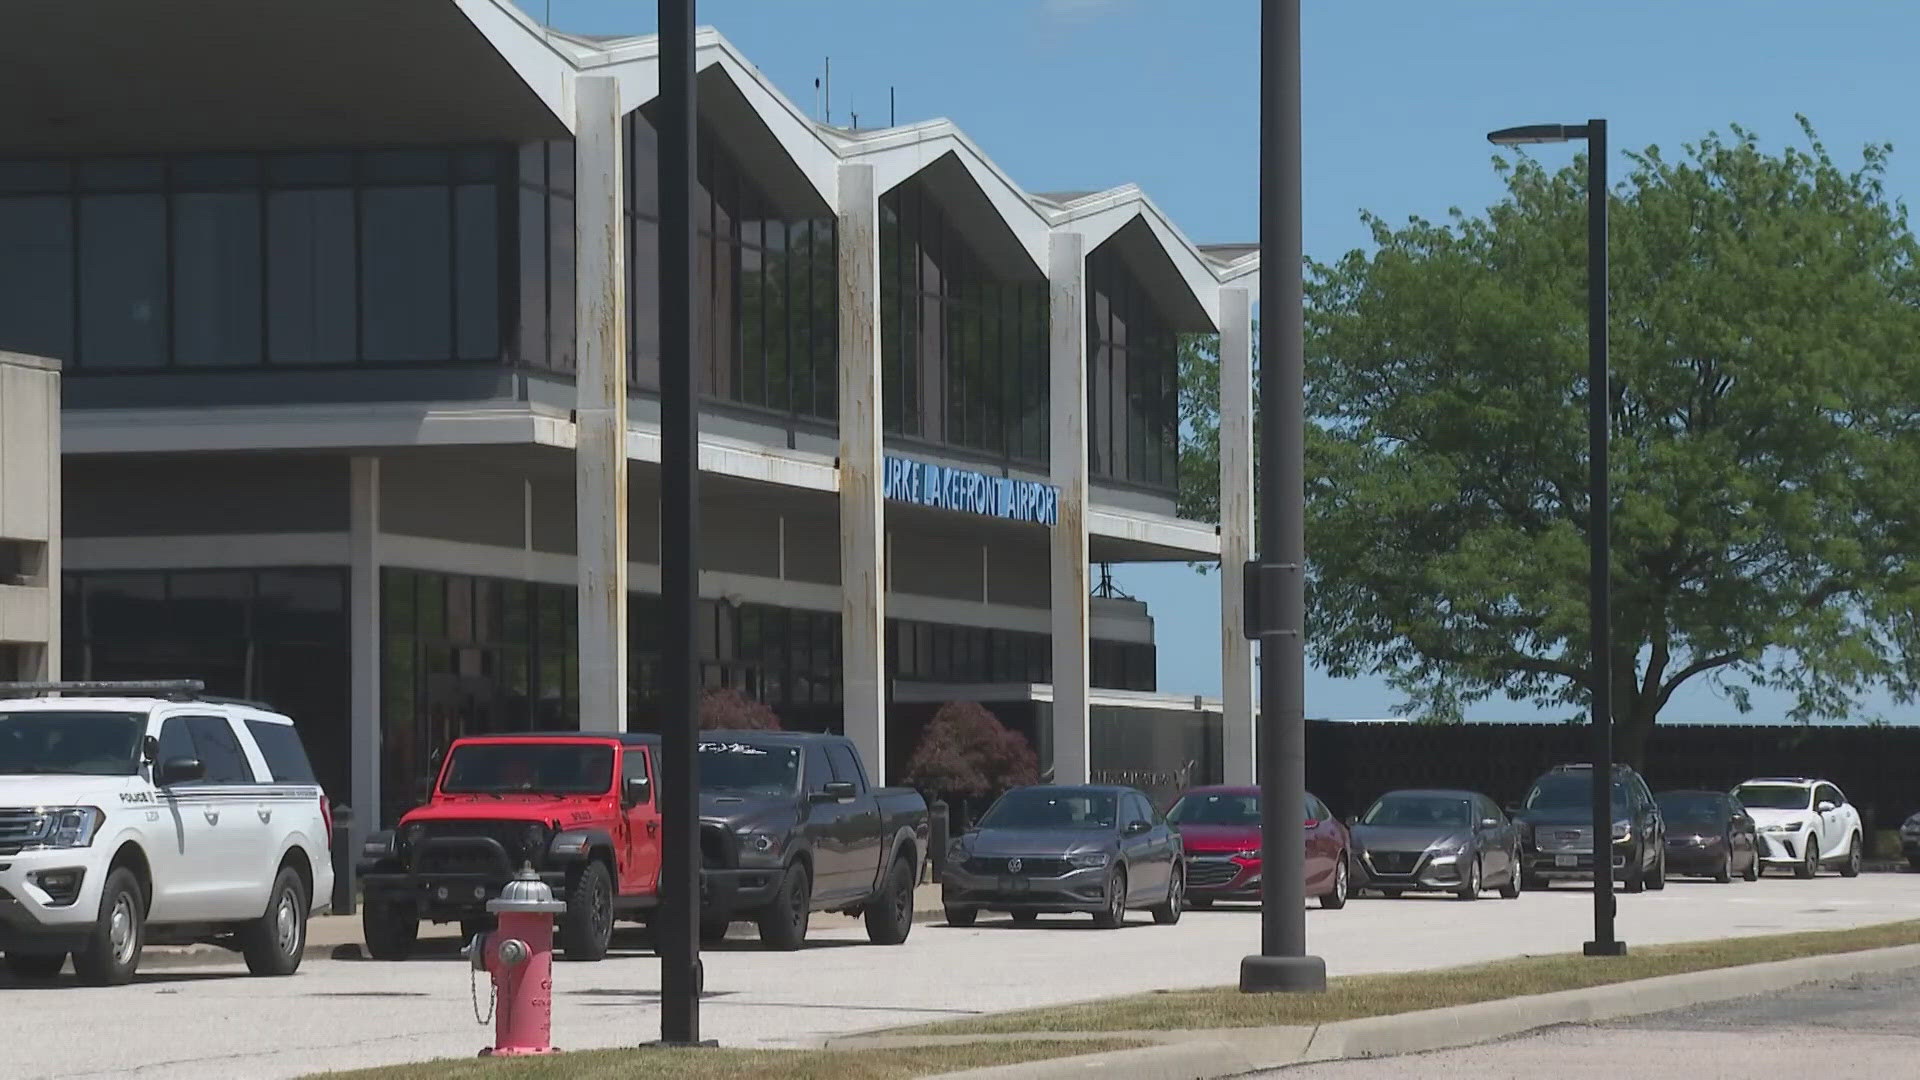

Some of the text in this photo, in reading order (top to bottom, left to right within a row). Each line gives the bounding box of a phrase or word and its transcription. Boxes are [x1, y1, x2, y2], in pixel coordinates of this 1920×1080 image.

[923, 463, 1003, 517] LAKEFRONT
[1006, 479, 1061, 527] AIRPORT
[119, 791, 149, 803] POLICE
